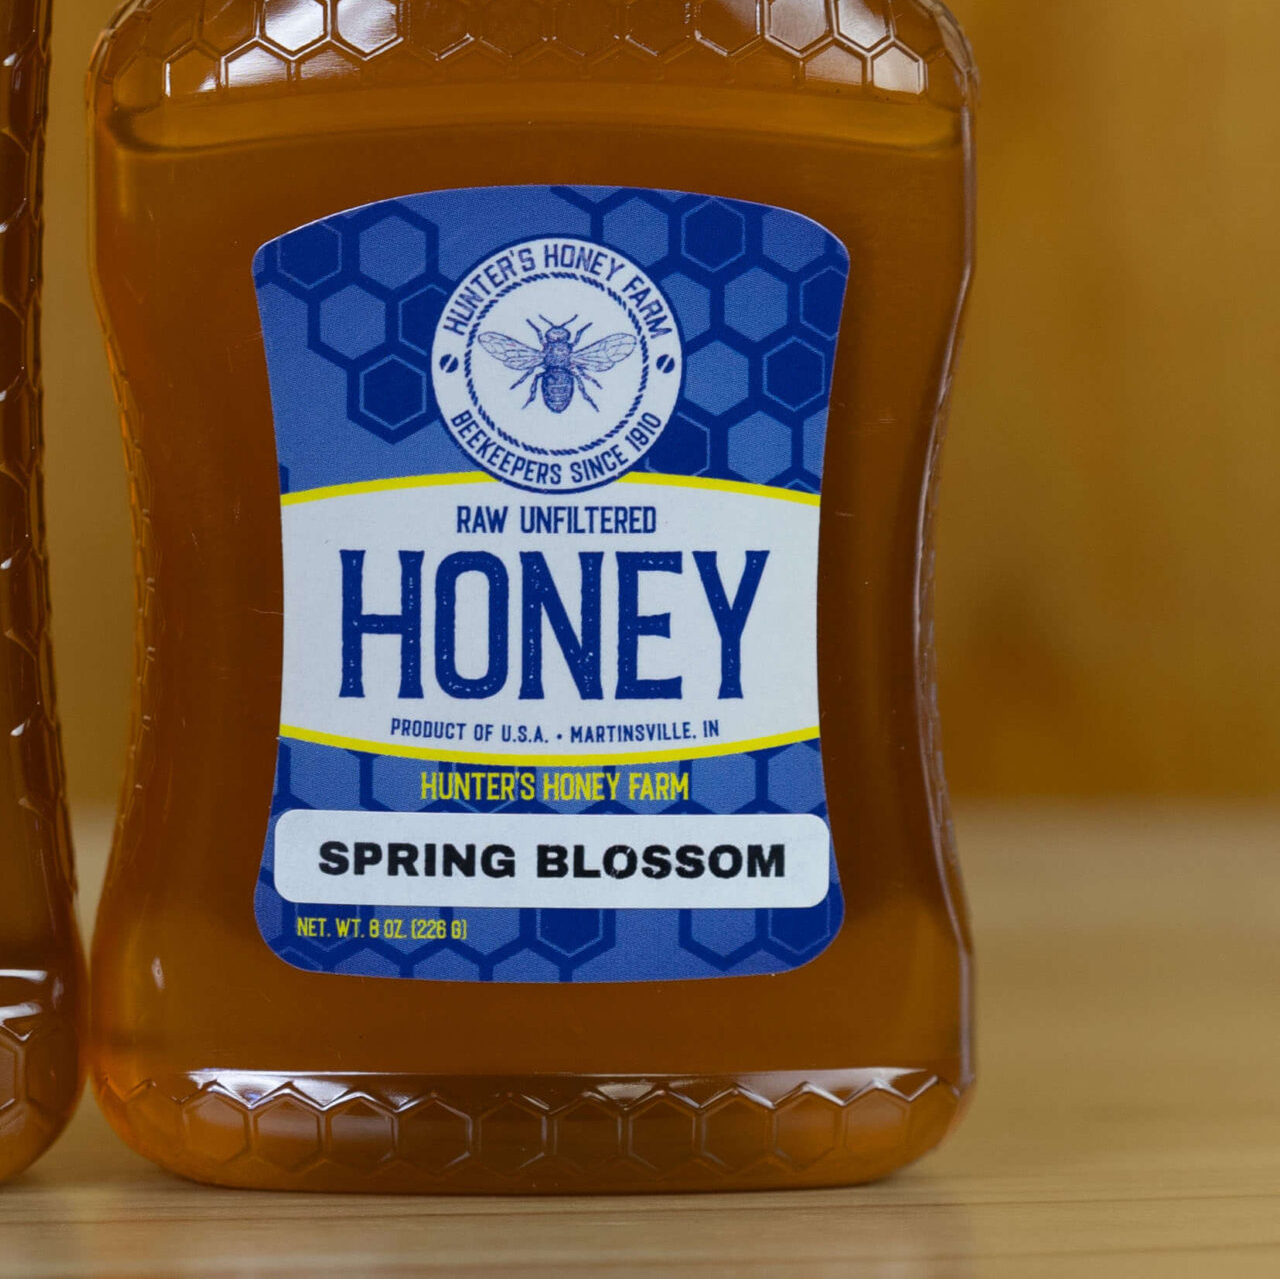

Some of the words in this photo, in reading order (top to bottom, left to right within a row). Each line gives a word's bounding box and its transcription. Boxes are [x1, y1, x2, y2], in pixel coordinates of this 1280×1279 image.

[442, 247, 536, 336] HUNTER'S
[544, 243, 626, 282] HONEY
[621, 275, 673, 340] FARM
[450, 409, 562, 485] BEEKEEPERS
[571, 444, 629, 484] SINCE
[624, 411, 662, 451] 1910
[456, 505, 509, 534] RAW
[519, 505, 657, 534] UNFILTERED
[338, 549, 770, 700] HONEY
[390, 717, 467, 740] PRODUCT
[473, 723, 494, 742] OF
[501, 724, 549, 743] U.S.A.
[703, 719, 720, 738] IN
[420, 772, 536, 801] HUNTER'S
[543, 772, 621, 801] HONEY
[628, 772, 689, 801] FARM
[318, 840, 516, 877] SPRING
[536, 844, 785, 880] BLOSSOM
[296, 916, 332, 937] NET.
[335, 917, 365, 938] WT.
[369, 919, 380, 938] 8
[384, 919, 408, 939] OZ.
